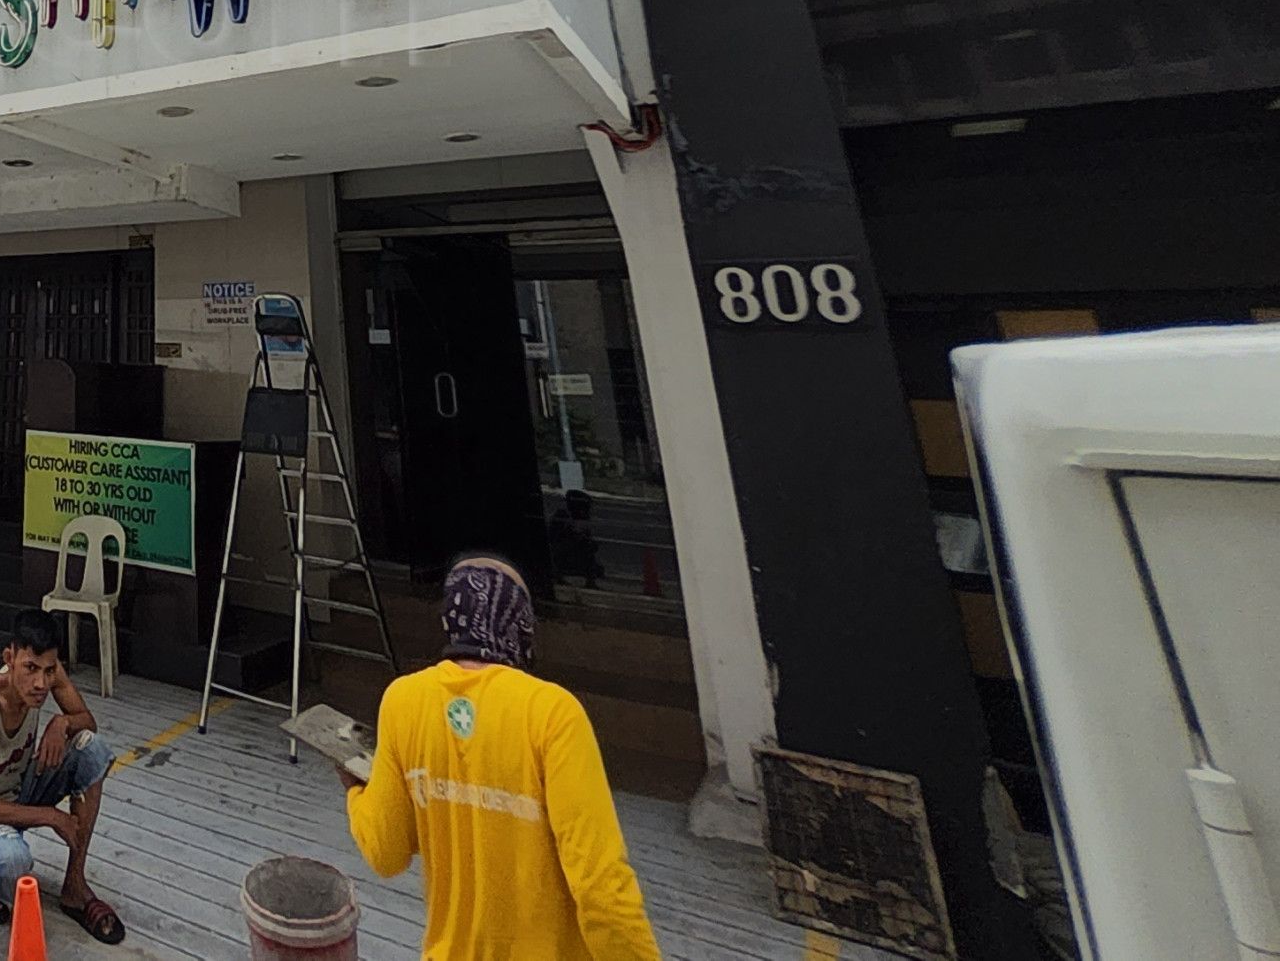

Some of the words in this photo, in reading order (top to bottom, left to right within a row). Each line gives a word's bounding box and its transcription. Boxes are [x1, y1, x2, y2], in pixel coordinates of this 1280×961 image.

[203, 283, 253, 297] NOTICE
[714, 263, 862, 324] 808
[206, 316, 249, 324] WORKPLACE
[69, 439, 108, 457] HIRING
[111, 443, 140, 460] CCA
[25, 454, 88, 475] (CUSTOMER
[90, 461, 123, 476] CARE
[124, 465, 191, 491] ASSISTANT)
[55, 477, 67, 493] 18
[70, 479, 85, 494] TO
[87, 481, 101, 497] 30
[103, 483, 124, 499] YRS
[126, 485, 153, 503] OLD
[53, 497, 80, 515] WITH
[83, 500, 101, 515] OR
[103, 503, 157, 526] WITHOUT
